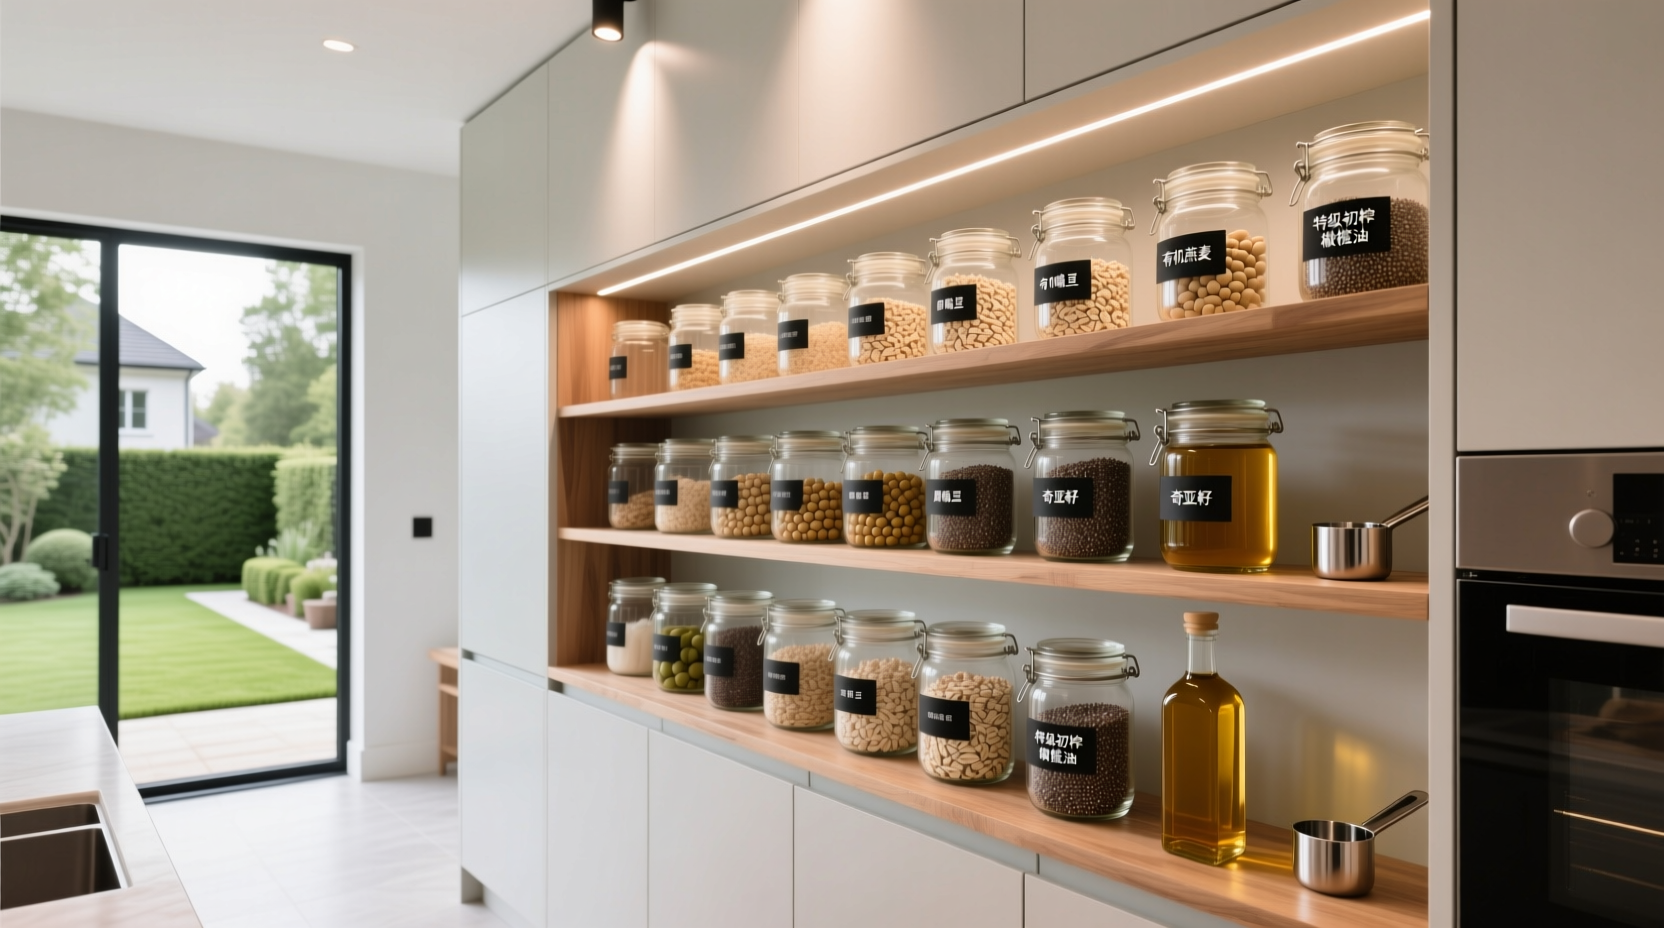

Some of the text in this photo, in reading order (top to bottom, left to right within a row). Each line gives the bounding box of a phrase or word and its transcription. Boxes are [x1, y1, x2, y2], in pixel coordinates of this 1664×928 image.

[1161, 244, 1212, 268] 有机燕麦
[1042, 488, 1079, 505] 奇亚籽
[1170, 488, 1213, 506] 奇亚籽
